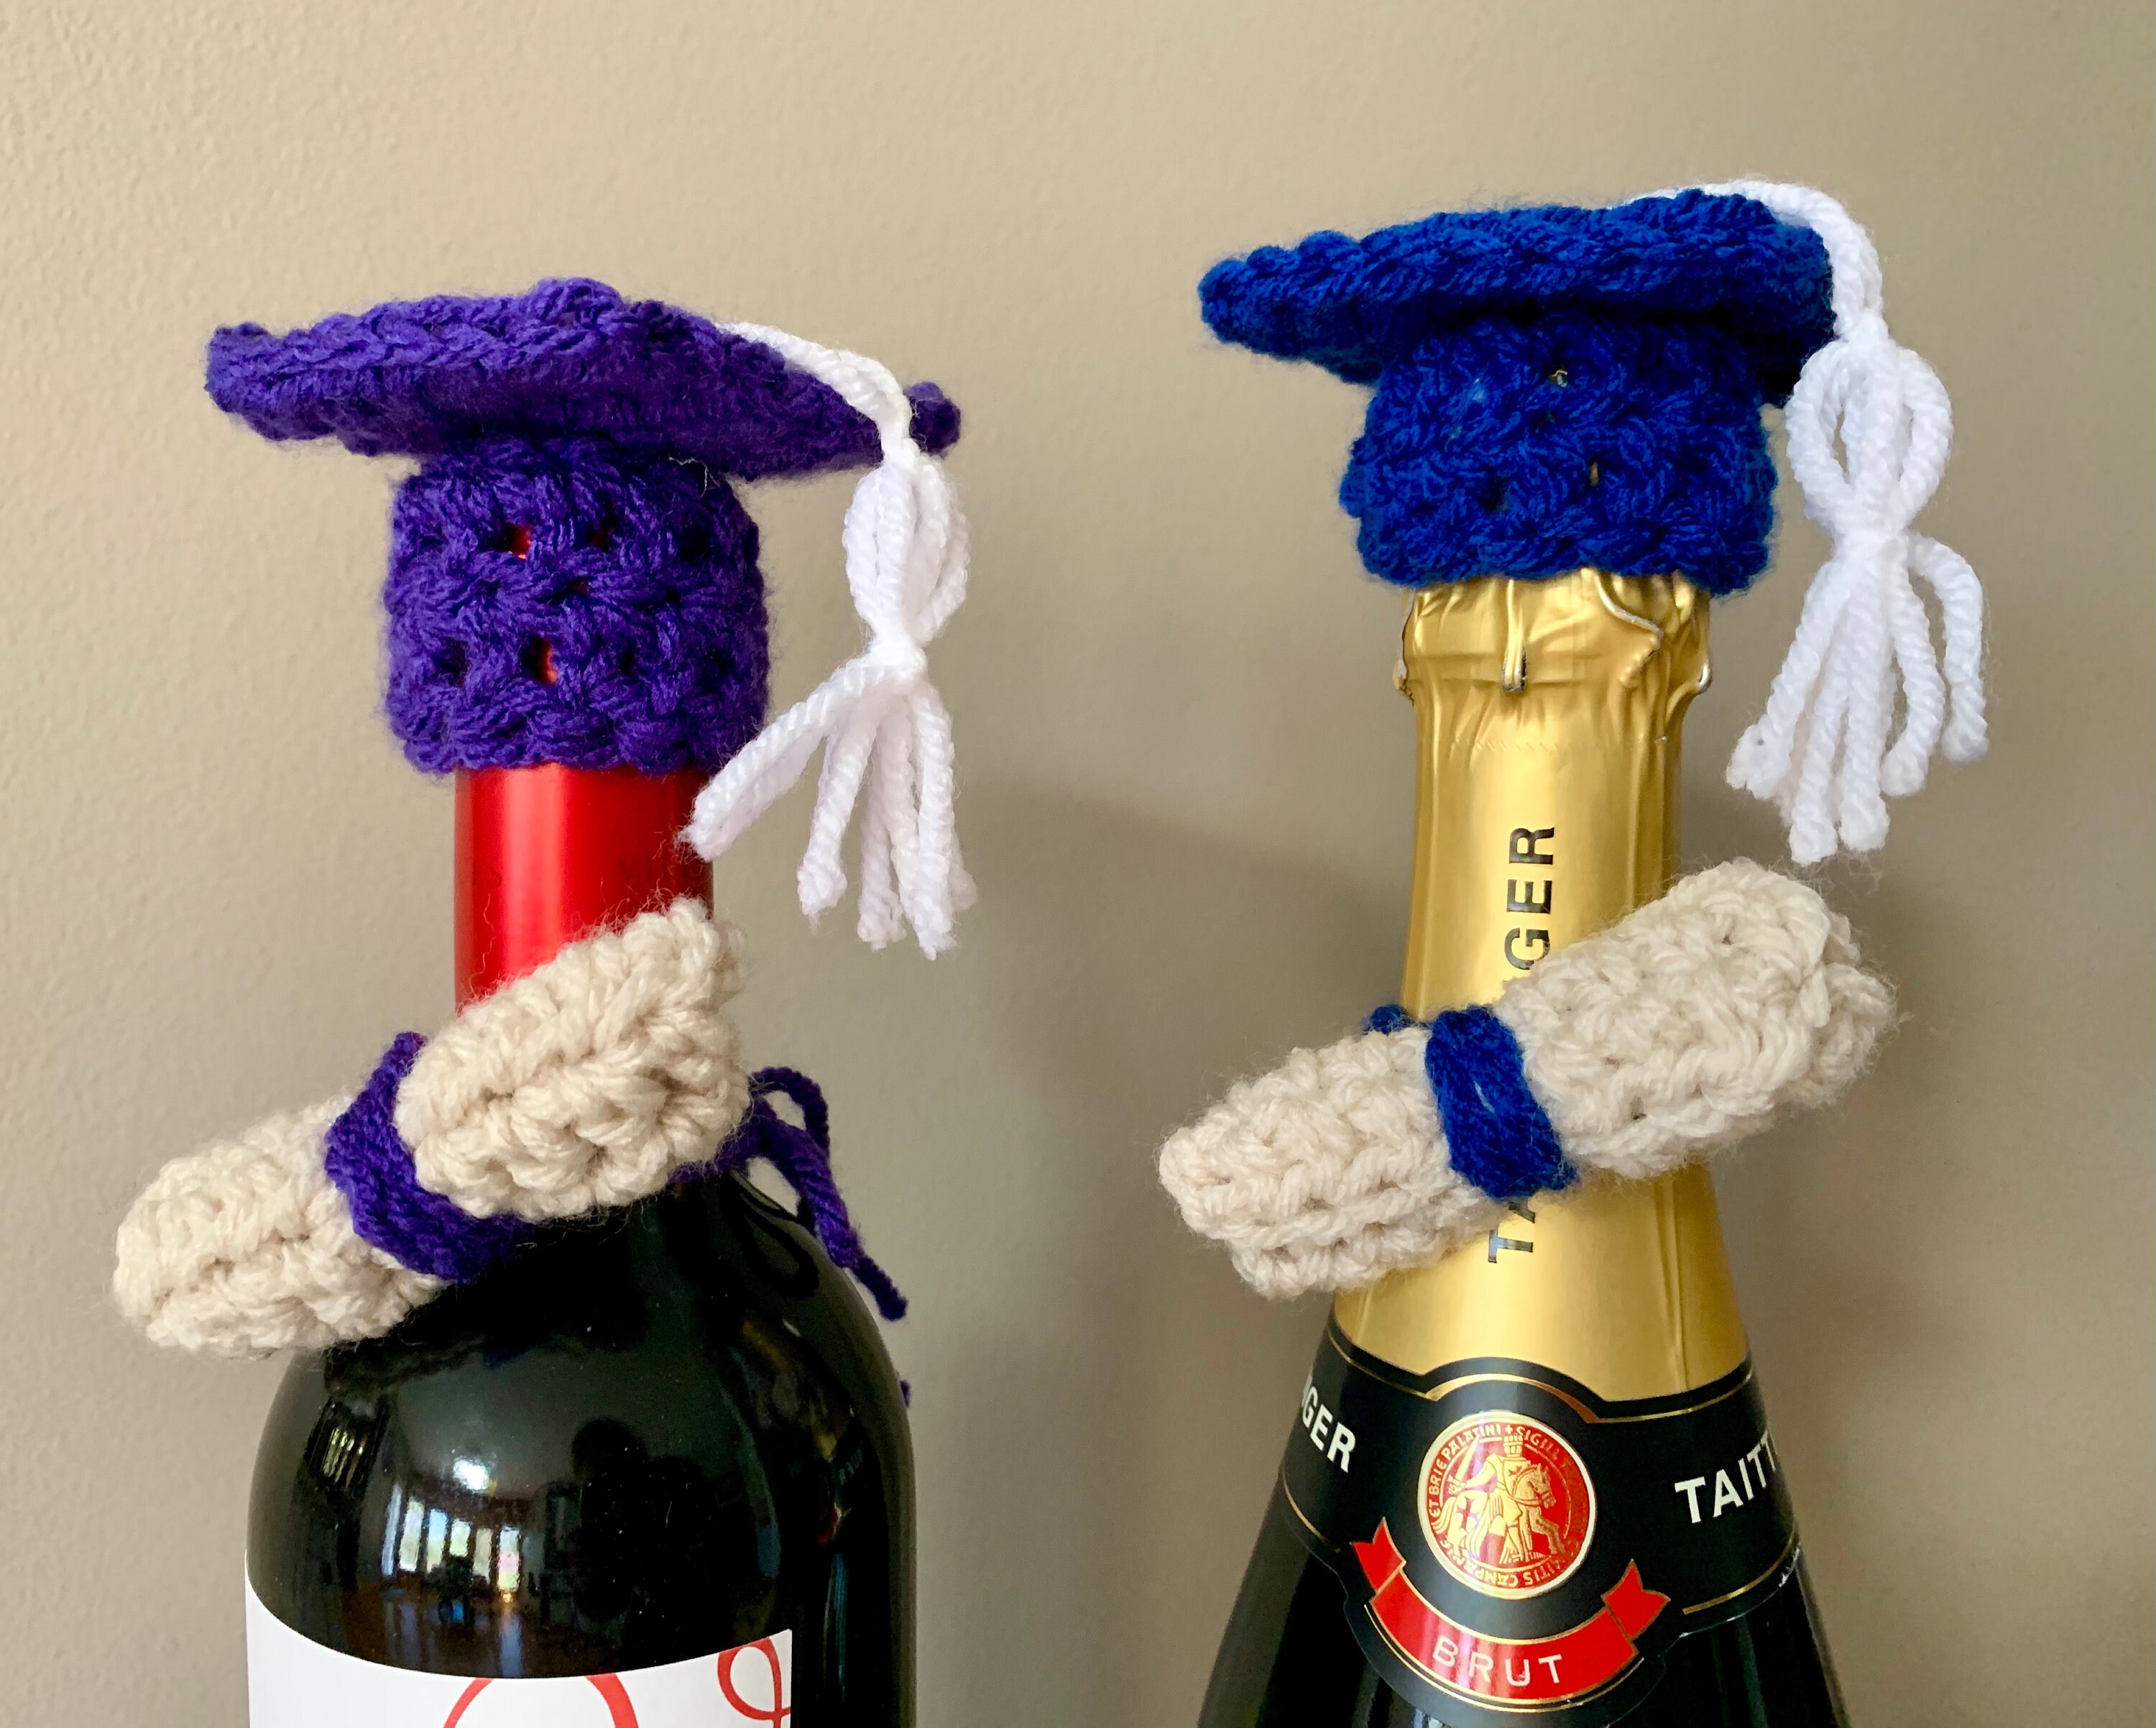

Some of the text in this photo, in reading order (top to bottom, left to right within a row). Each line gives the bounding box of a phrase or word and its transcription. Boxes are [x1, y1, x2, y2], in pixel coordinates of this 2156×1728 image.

[1302, 1370, 1355, 1473] GER
[1429, 1458, 1447, 1495] BRIE
[1432, 1635, 1562, 1686] BRUT
